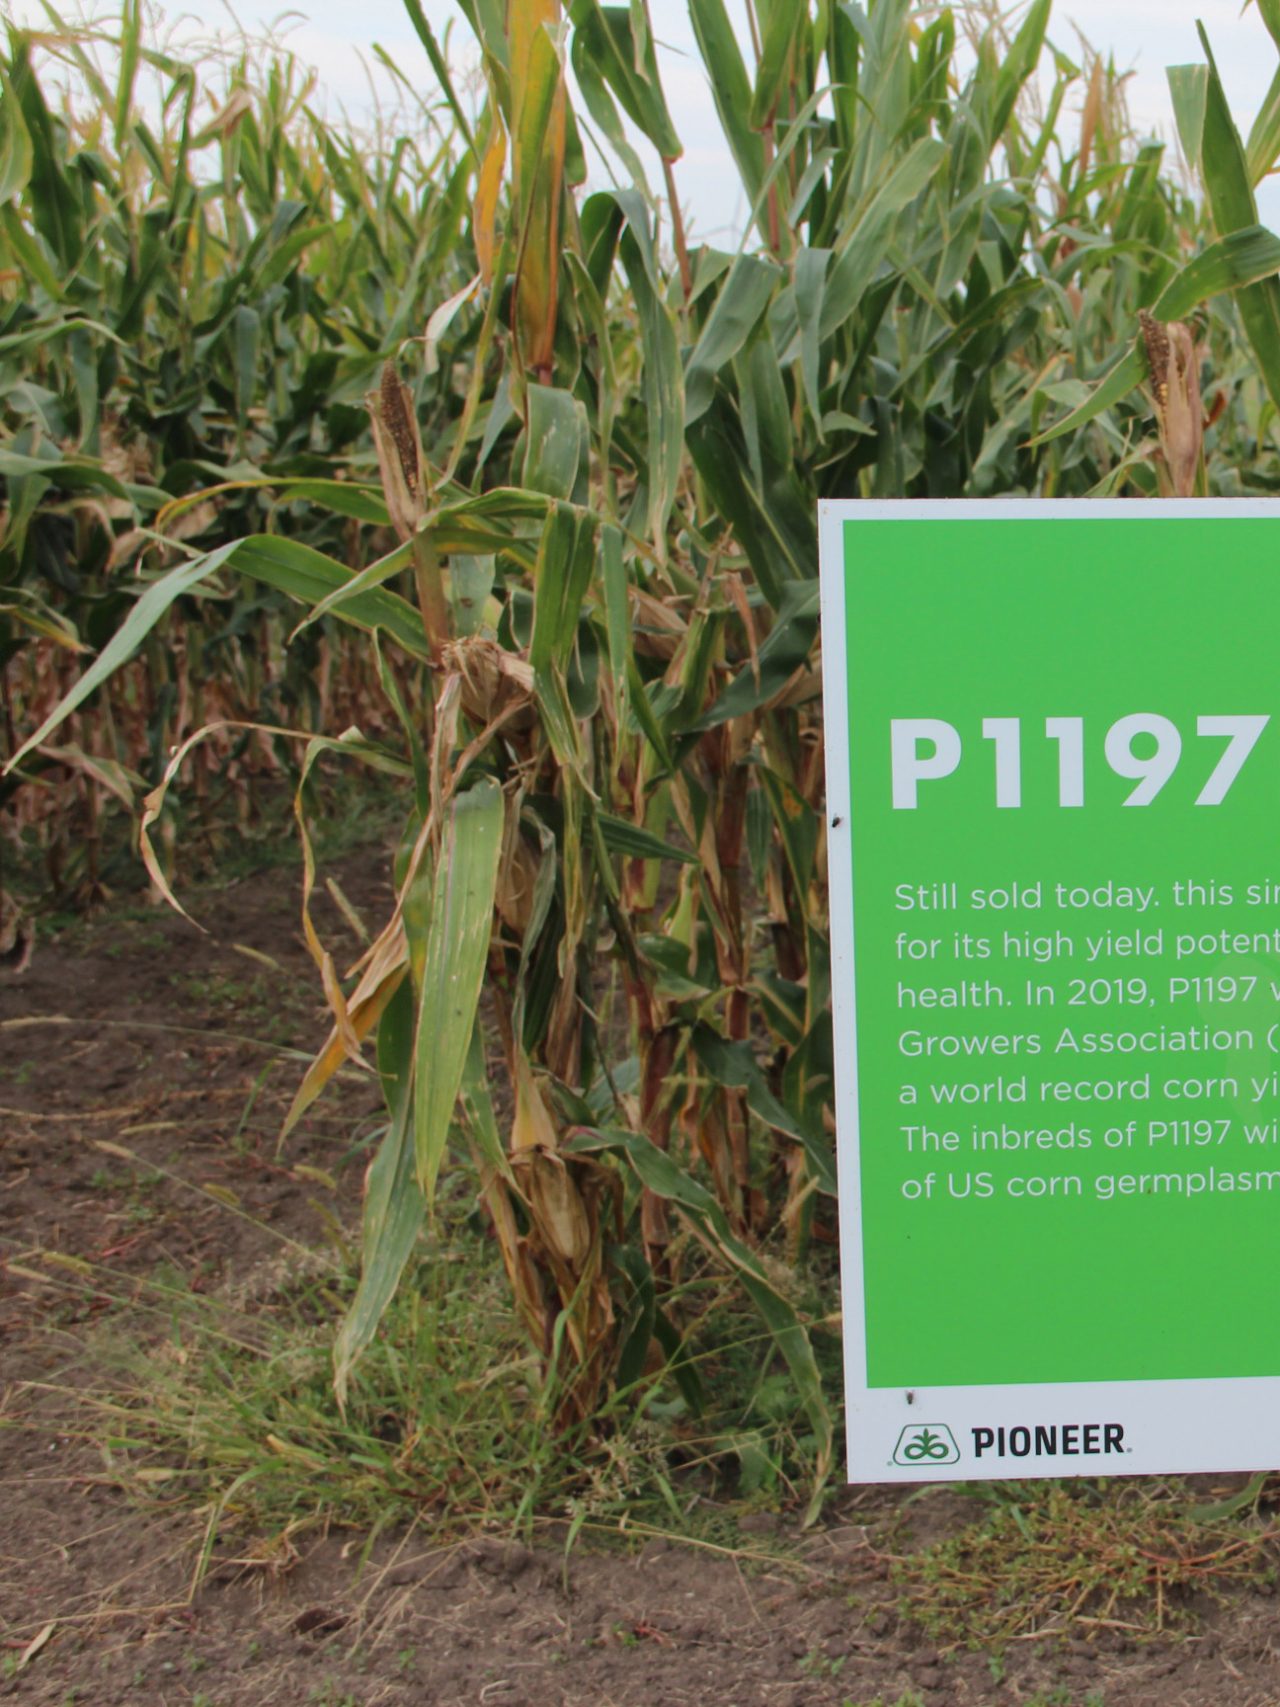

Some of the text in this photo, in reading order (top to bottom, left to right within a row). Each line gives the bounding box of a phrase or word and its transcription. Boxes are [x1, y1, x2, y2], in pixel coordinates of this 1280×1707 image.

[895, 882, 957, 911] Still
[971, 881, 1041, 910] sold
[1172, 879, 1233, 907] this
[895, 932, 942, 960] for
[954, 932, 991, 959] its
[1003, 930, 1073, 963] high
[1086, 928, 1163, 962] yield
[897, 980, 1012, 1009] health.
[1026, 980, 1055, 1006] In
[1067, 977, 1155, 1007] 2019,
[1169, 975, 1258, 1003] P1197
[898, 1030, 1041, 1057] Growers
[1054, 1025, 1254, 1053] Association
[898, 1084, 917, 1105] a
[930, 1075, 1026, 1104] world
[1040, 1072, 1150, 1102] record
[1163, 1077, 1238, 1099] corn
[899, 1125, 960, 1152] The
[972, 1122, 1092, 1150] inbreds
[1103, 1120, 1137, 1148] of
[1148, 1119, 1231, 1146] P1197
[901, 1172, 936, 1200] of
[948, 1172, 994, 1198] US
[1007, 1176, 1082, 1197] corn
[971, 1423, 1124, 1458] PIONEER
